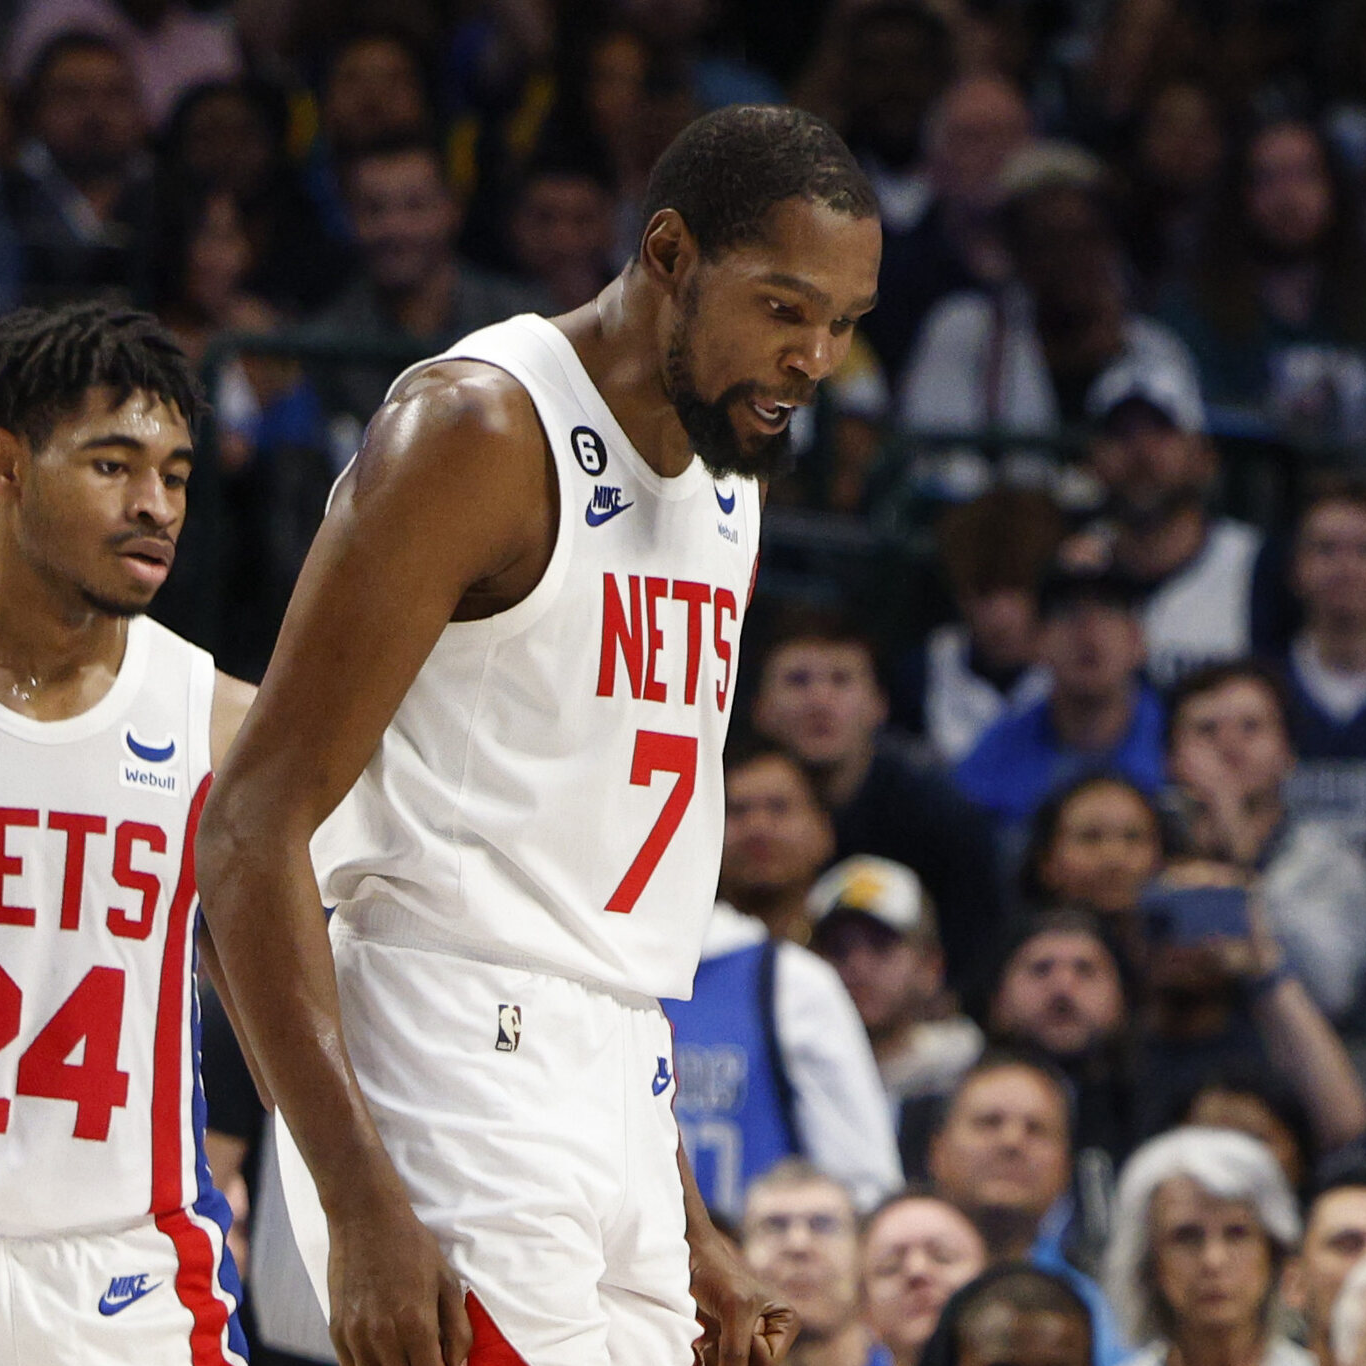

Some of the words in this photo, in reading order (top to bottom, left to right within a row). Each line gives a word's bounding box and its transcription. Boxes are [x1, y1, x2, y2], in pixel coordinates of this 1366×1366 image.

[576, 433, 601, 471] 6
[593, 485, 622, 511] NIKE
[717, 520, 738, 544] Webull
[596, 571, 738, 713] NETS
[125, 767, 176, 791] Webull
[603, 729, 698, 914] 7
[107, 1273, 149, 1298] NIKE
